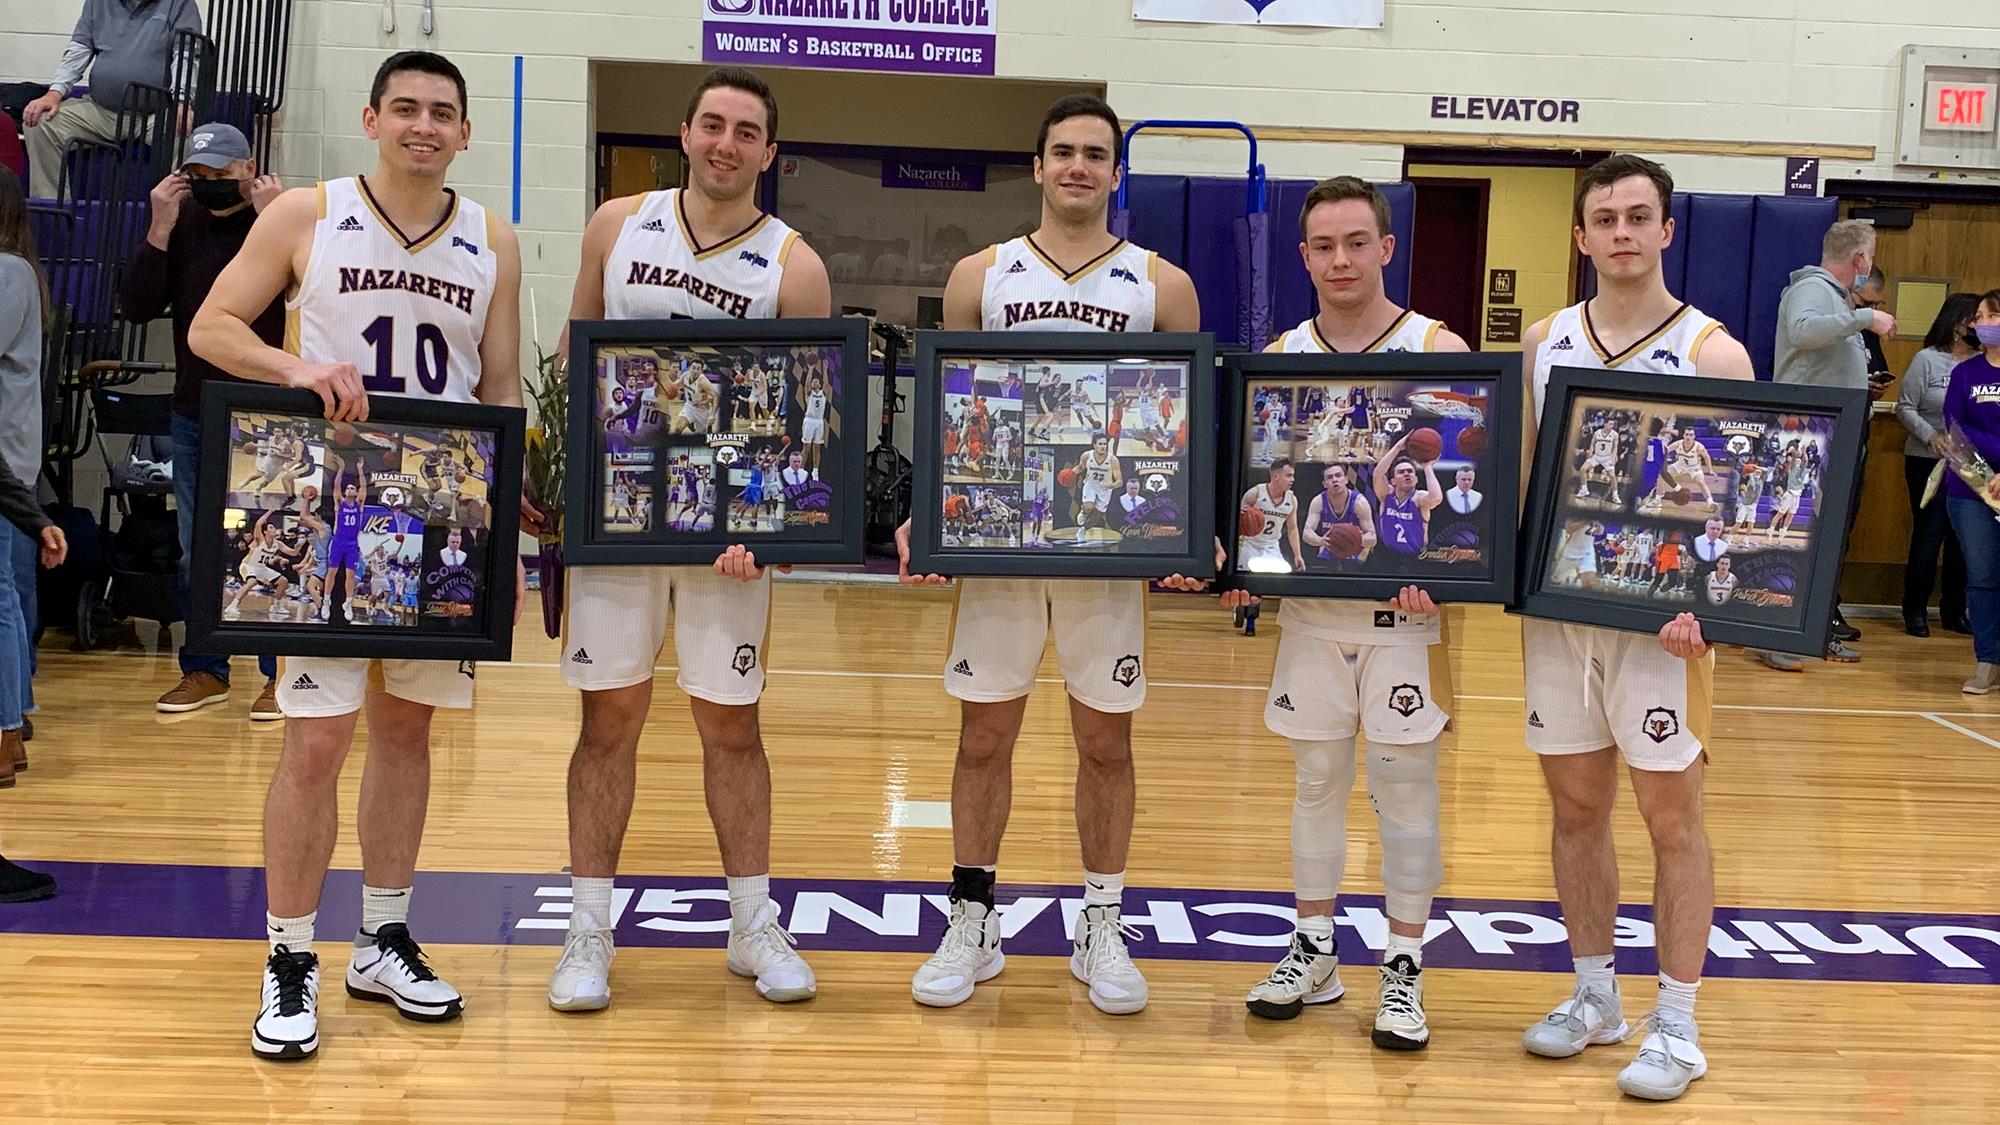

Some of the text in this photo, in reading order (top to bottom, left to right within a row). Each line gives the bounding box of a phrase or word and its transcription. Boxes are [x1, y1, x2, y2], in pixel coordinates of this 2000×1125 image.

[806, 37, 915, 60] BASKETBALL
[922, 42, 983, 63] OFFICE
[1431, 96, 1580, 122] ELEVATOR
[1938, 88, 1987, 125] EXIT
[898, 164, 961, 181] Nazareth
[339, 266, 476, 316] NAZARETH
[626, 261, 753, 320] NAZARETH
[1004, 301, 1130, 332] NAZARETH
[361, 315, 450, 396] 10
[1719, 420, 1766, 433] NAZARETH
[706, 433, 749, 443] NAZARETH
[1135, 461, 1178, 471] NAZARETH
[371, 472, 417, 484] NAZARETH
[343, 514, 356, 526] 10
[363, 514, 394, 534] IKE
[1263, 520, 1276, 535] 2
[1394, 523, 1408, 543] 2
[431, 577, 459, 600] WITH
[1716, 592, 1724, 602] 3
[291, 682, 319, 690] adidas
